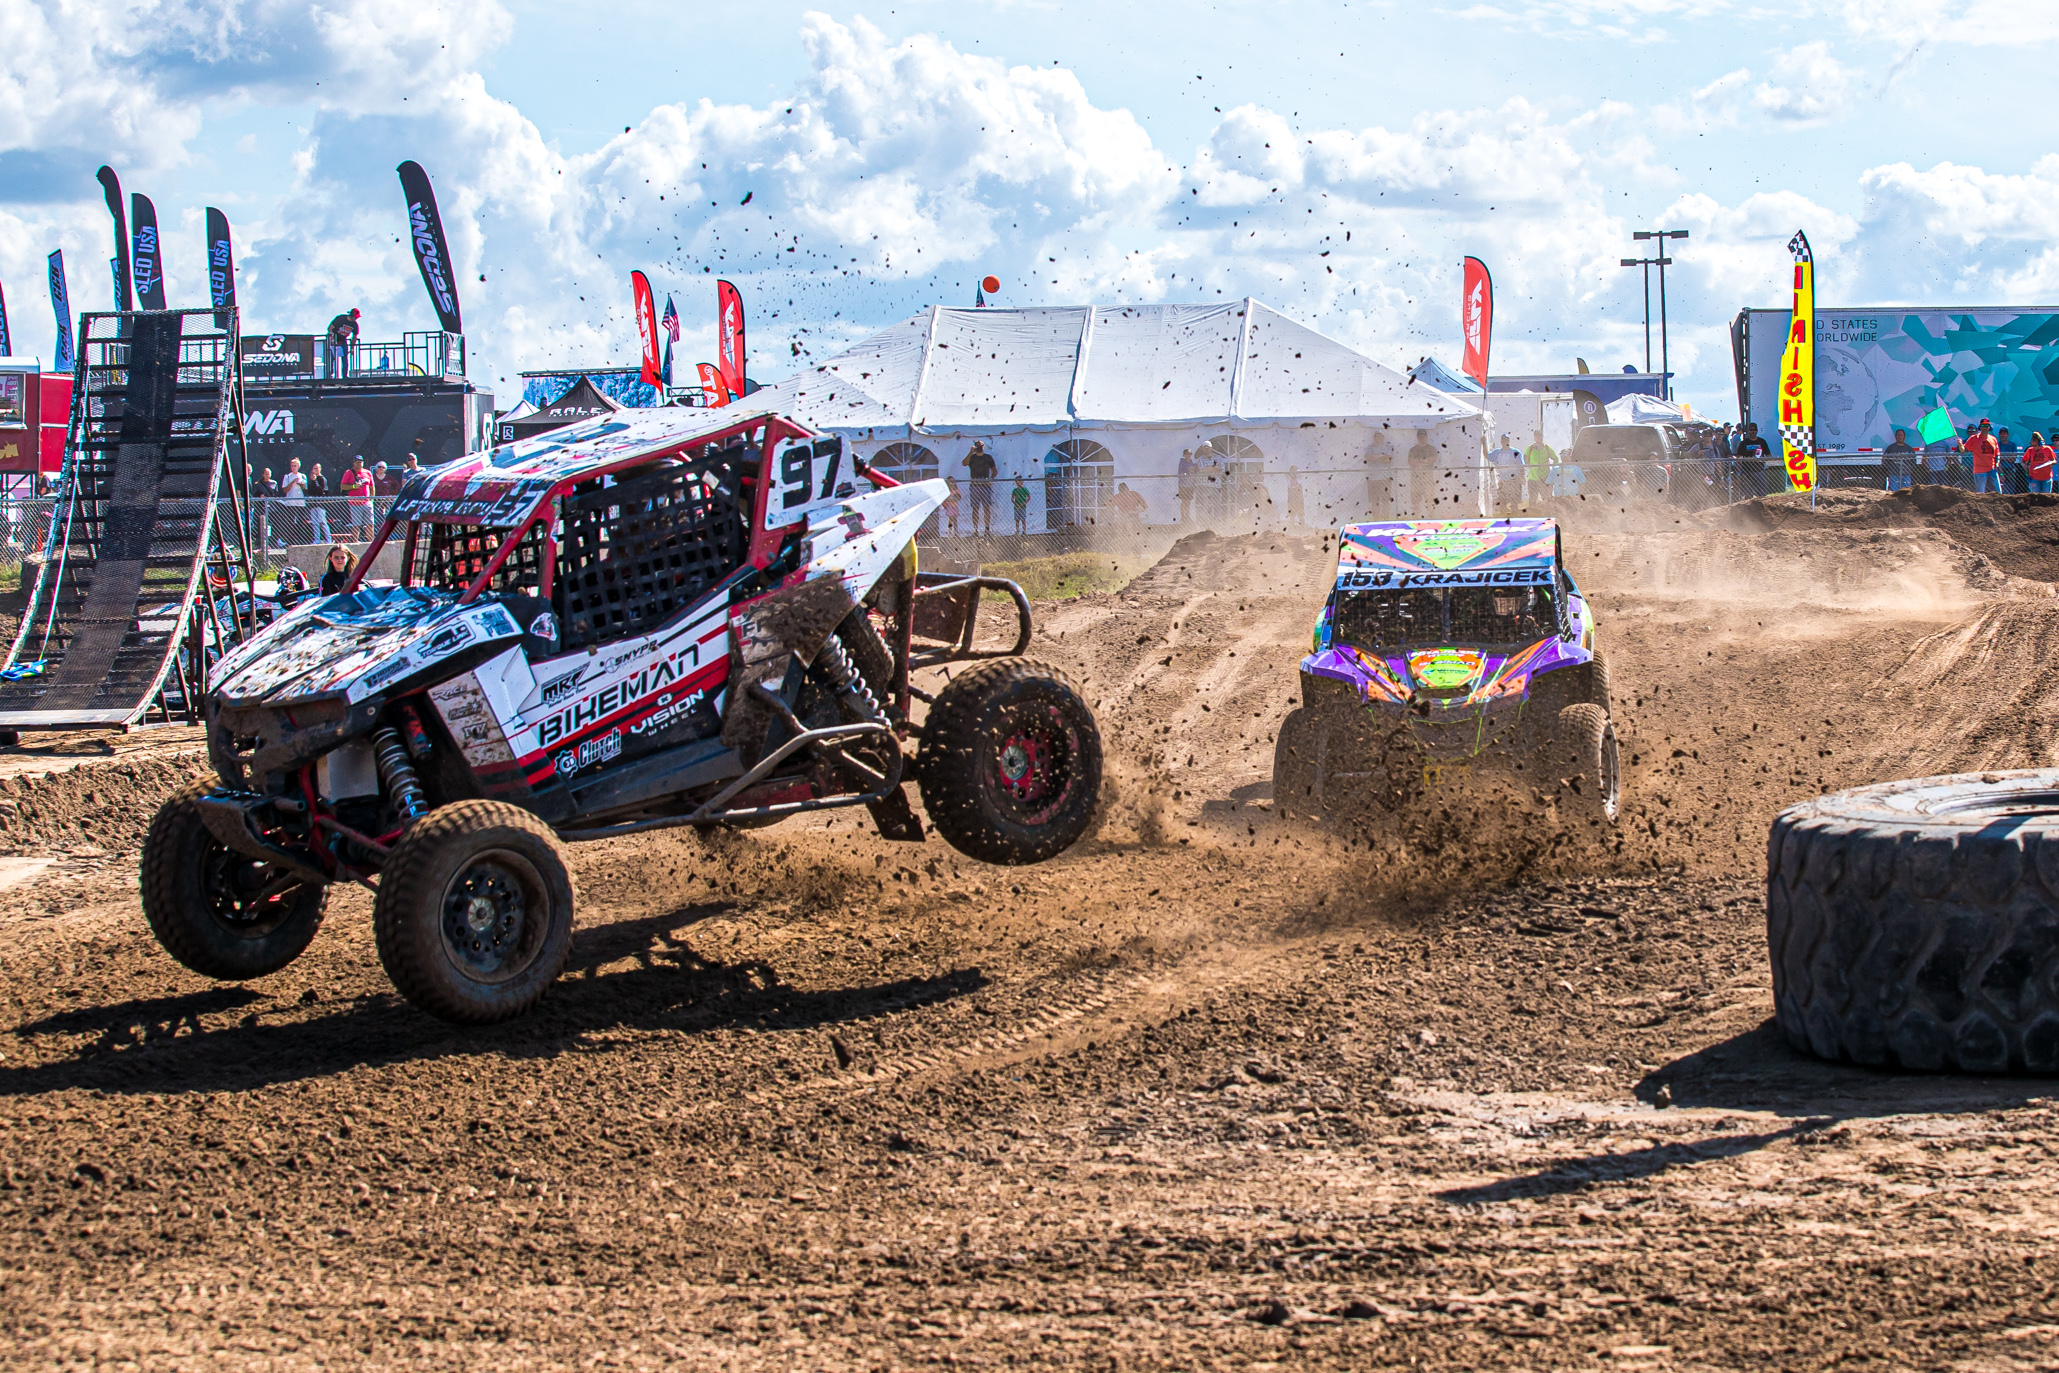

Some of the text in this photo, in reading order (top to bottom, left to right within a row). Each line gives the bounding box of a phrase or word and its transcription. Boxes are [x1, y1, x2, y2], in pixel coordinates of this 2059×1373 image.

[134, 225, 158, 294] SLED USA
[211, 239, 230, 306] SLED USA
[410, 202, 457, 317] SEDONA
[1816, 332, 1878, 342] ORLDWIDE
[1831, 319, 1878, 330] STATES
[241, 352, 301, 364] SEDONA
[781, 436, 842, 510] 97
[1341, 569, 1551, 587] 153 KRAJICEK
[538, 643, 700, 748] BIKEMAN
[543, 669, 585, 702] MRT
[630, 687, 705, 735] VISION
[647, 708, 698, 736] WHEEL
